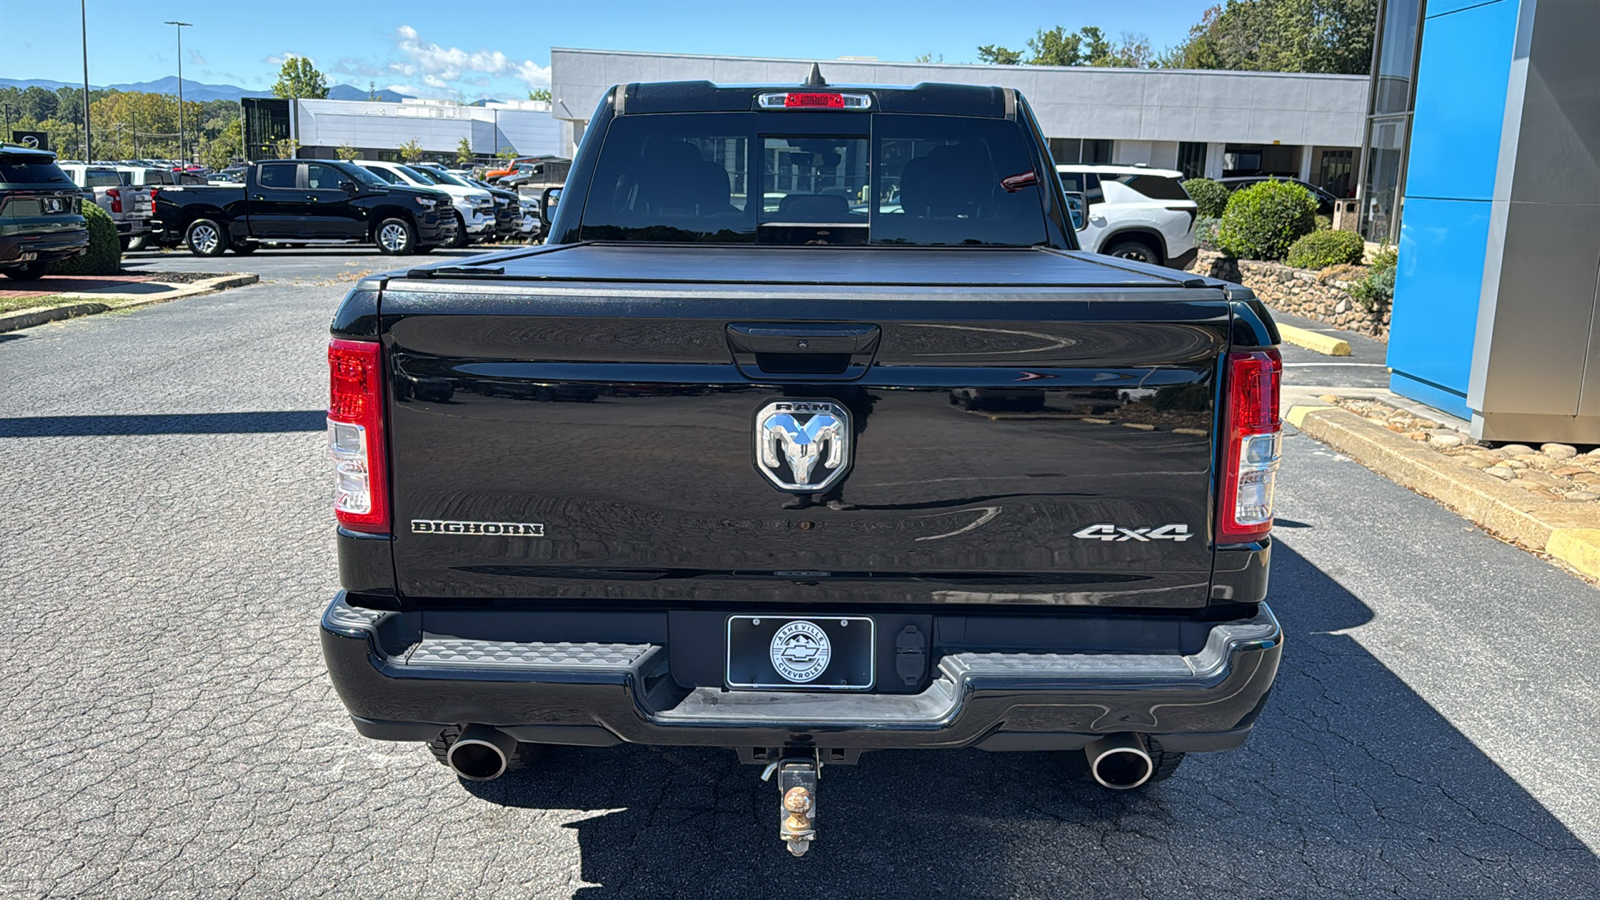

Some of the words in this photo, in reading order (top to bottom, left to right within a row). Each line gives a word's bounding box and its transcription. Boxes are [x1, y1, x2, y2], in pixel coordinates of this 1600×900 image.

[775, 403, 830, 411] RAM
[411, 520, 544, 536] BIGHORN
[1072, 524, 1195, 541] 4x4
[777, 625, 825, 642] ASHEVILLE
[778, 662, 822, 678] CHEVROLET
